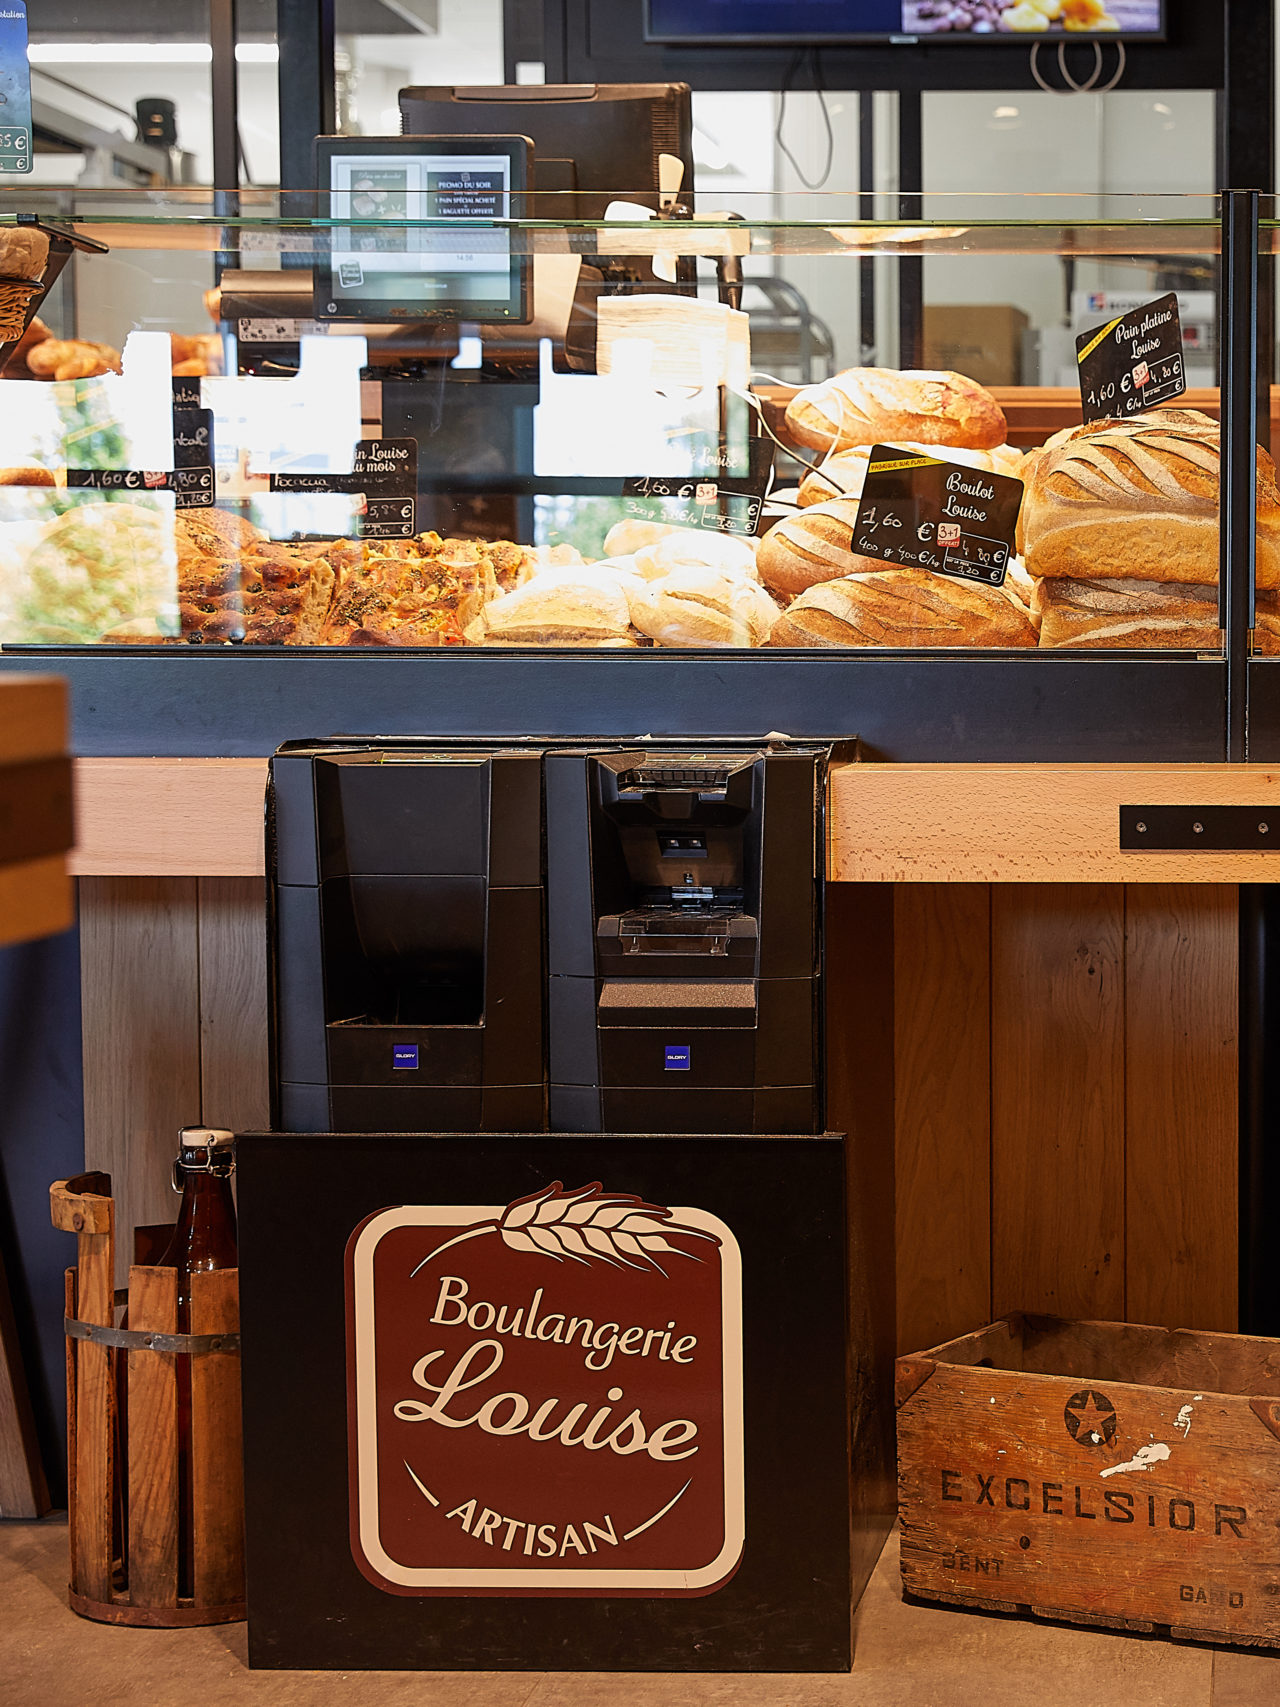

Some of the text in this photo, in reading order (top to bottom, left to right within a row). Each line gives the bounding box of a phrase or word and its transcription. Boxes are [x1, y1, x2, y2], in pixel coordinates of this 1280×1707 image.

[1116, 324, 1139, 344] Pain
[1140, 310, 1172, 338] platine
[1131, 338, 1160, 359] Louise
[1120, 373, 1132, 393] €
[369, 443, 408, 461] Louise
[367, 461, 396, 472] mois
[201, 474, 211, 487] €
[946, 472, 994, 500] Boulot
[677, 484, 694, 502] €
[401, 505, 411, 518] €
[942, 495, 987, 522] Louise
[862, 507, 935, 542] 1,60 €
[939, 526, 958, 539] 3+1
[993, 550, 1005, 563] €
[430, 1276, 697, 1371] Boulangerie
[393, 1339, 699, 1461] Louise
[942, 1469, 1248, 1539] EXCELSIOR
[446, 1499, 619, 1557] ARTISAN
[1180, 1584, 1244, 1609] GAD
